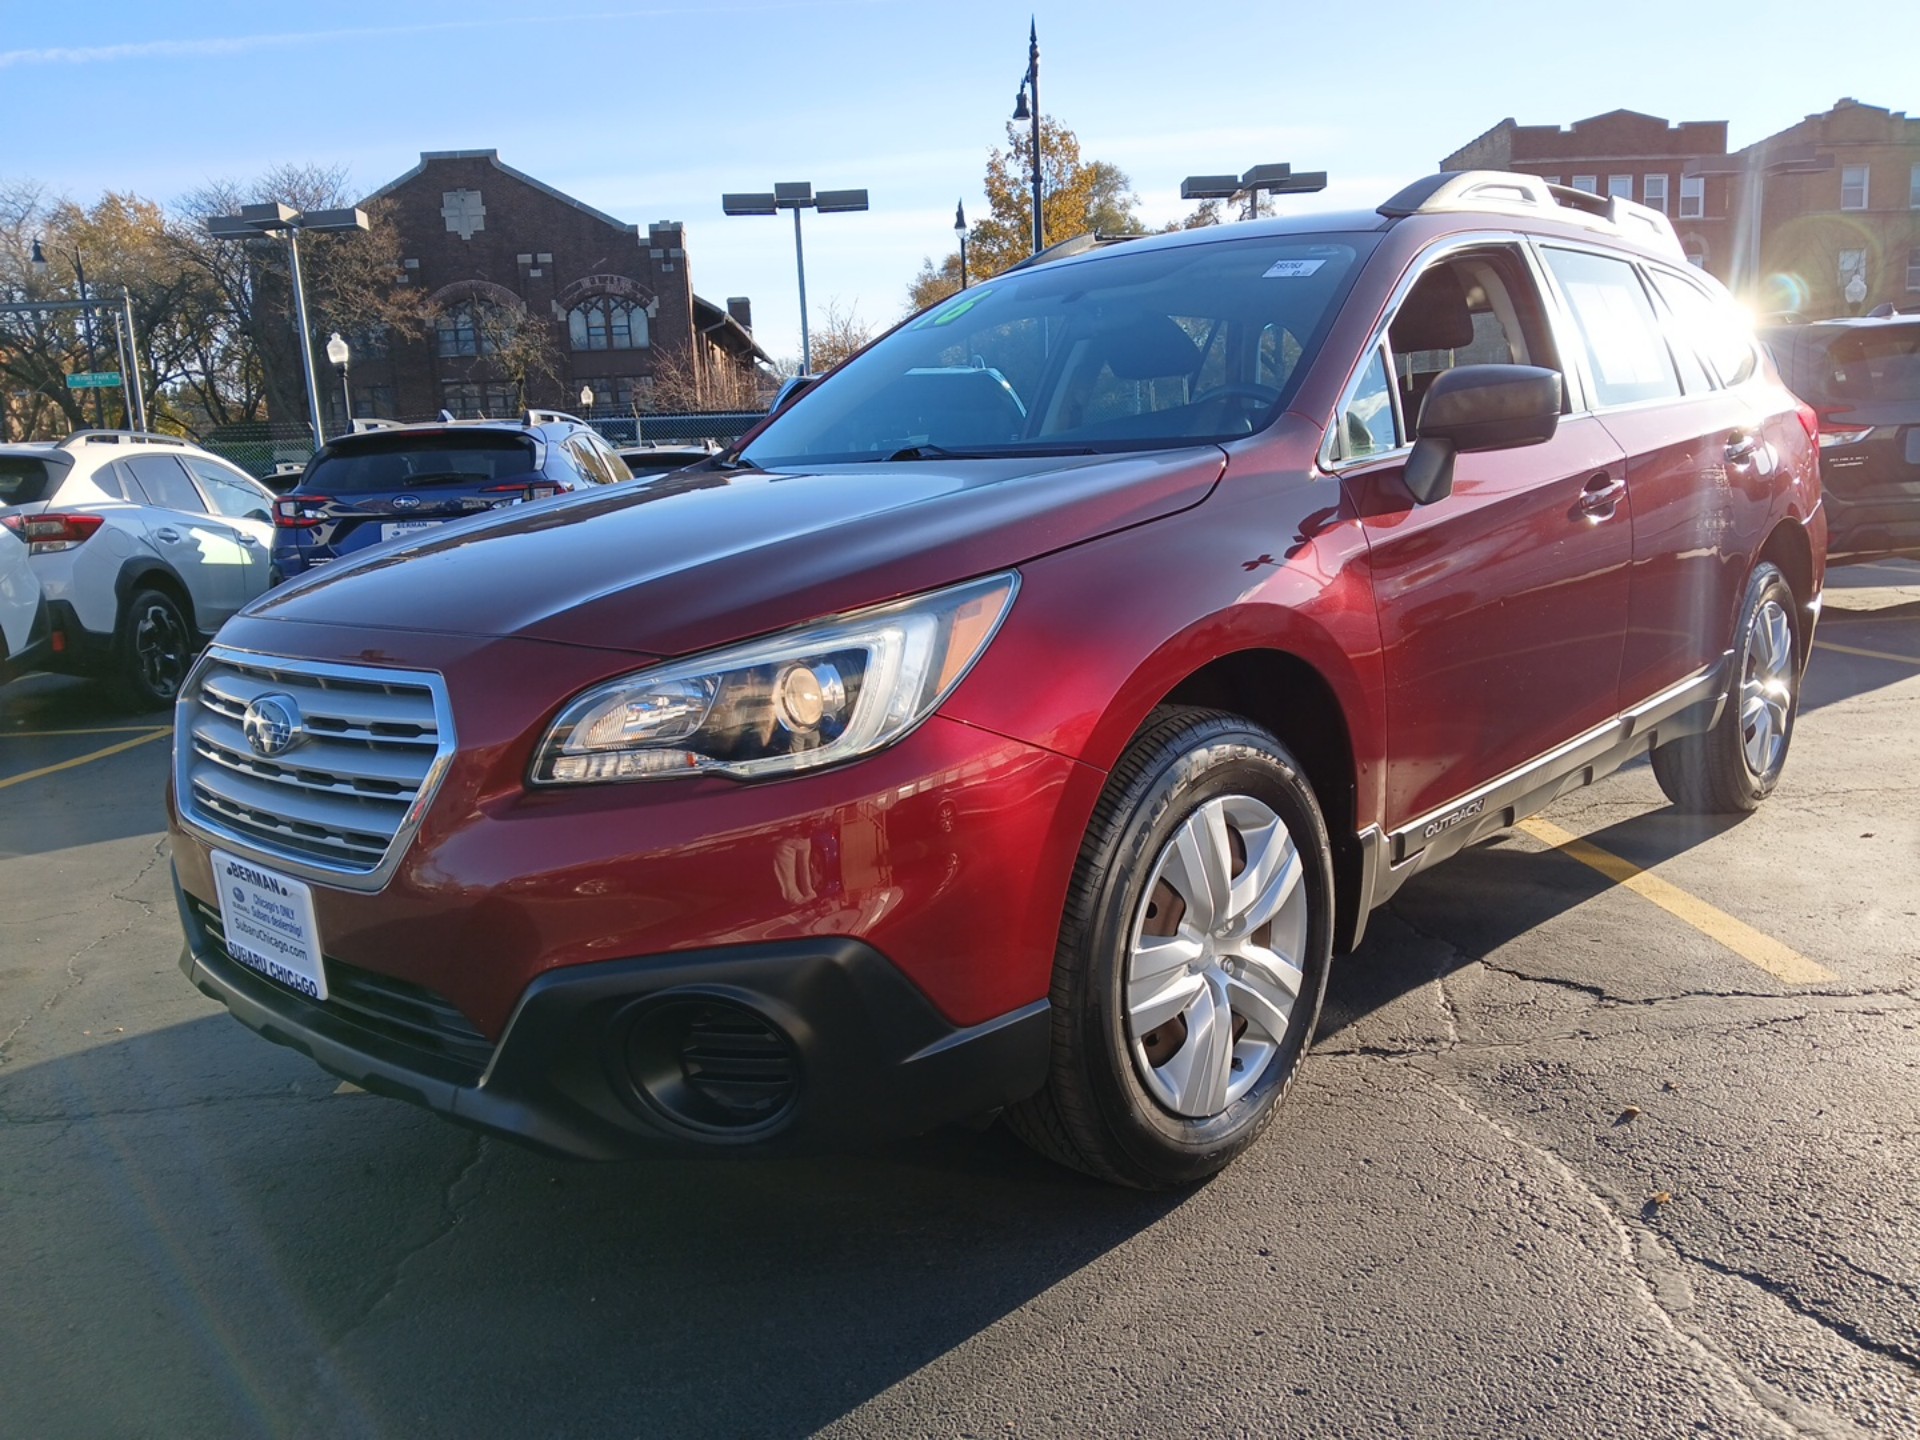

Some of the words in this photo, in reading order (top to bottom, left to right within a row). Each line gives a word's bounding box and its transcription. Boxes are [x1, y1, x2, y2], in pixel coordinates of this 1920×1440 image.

[1424, 798, 1485, 838] OUTBACK
[230, 862, 281, 896] BERMAN
[251, 906, 270, 924] Subaru
[253, 893, 280, 915] Chicago's
[280, 904, 295, 920] ONLY
[234, 918, 308, 961] SubaruChicago.com
[228, 941, 267, 974] SUBARU
[269, 962, 318, 997] CHICAGO
